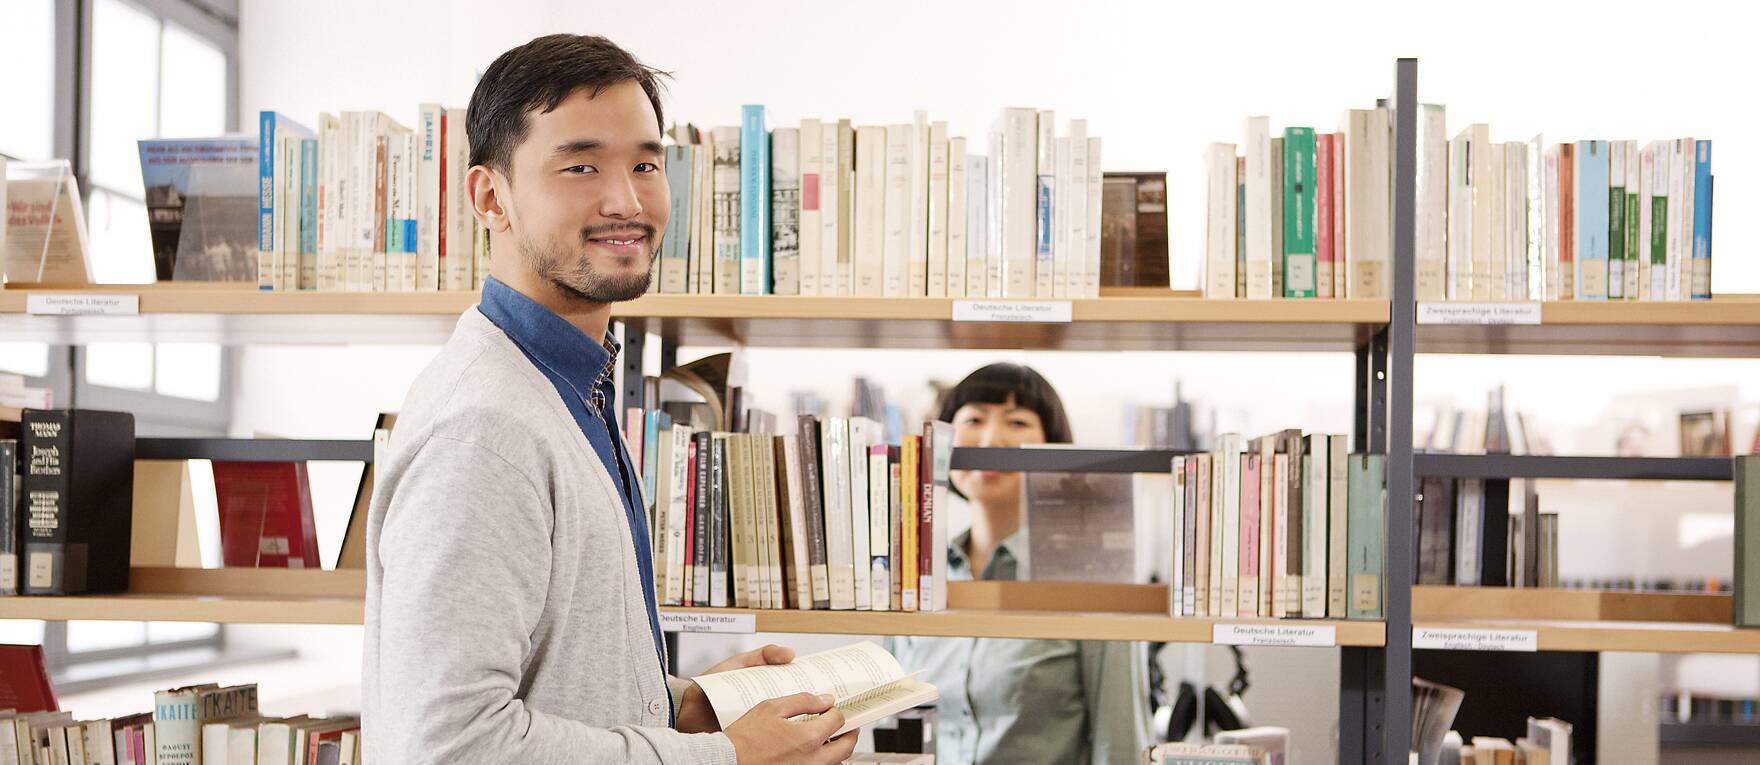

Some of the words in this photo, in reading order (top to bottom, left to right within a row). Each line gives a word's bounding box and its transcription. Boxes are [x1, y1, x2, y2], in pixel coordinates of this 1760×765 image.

[86, 297, 120, 306] Literatur
[972, 303, 1013, 312] Deutsche
[1015, 303, 1052, 312] Literatur
[1494, 306, 1532, 315] Literatur
[30, 422, 61, 431] THOMAS
[700, 437, 708, 450] THE
[31, 445, 59, 459] Joseph
[700, 451, 708, 469] FILM
[30, 463, 61, 475] Brothers
[699, 470, 707, 508] EXPLAINER
[923, 483, 933, 523] DEMIAN
[660, 614, 699, 622] Deutsche
[701, 614, 737, 623] Literatur
[682, 624, 712, 632] Englisch
[1233, 626, 1275, 635] Deutsche
[1277, 627, 1315, 637] Literatur
[1422, 631, 1487, 642] Zweisprachige
[1489, 632, 1528, 641] Literatur
